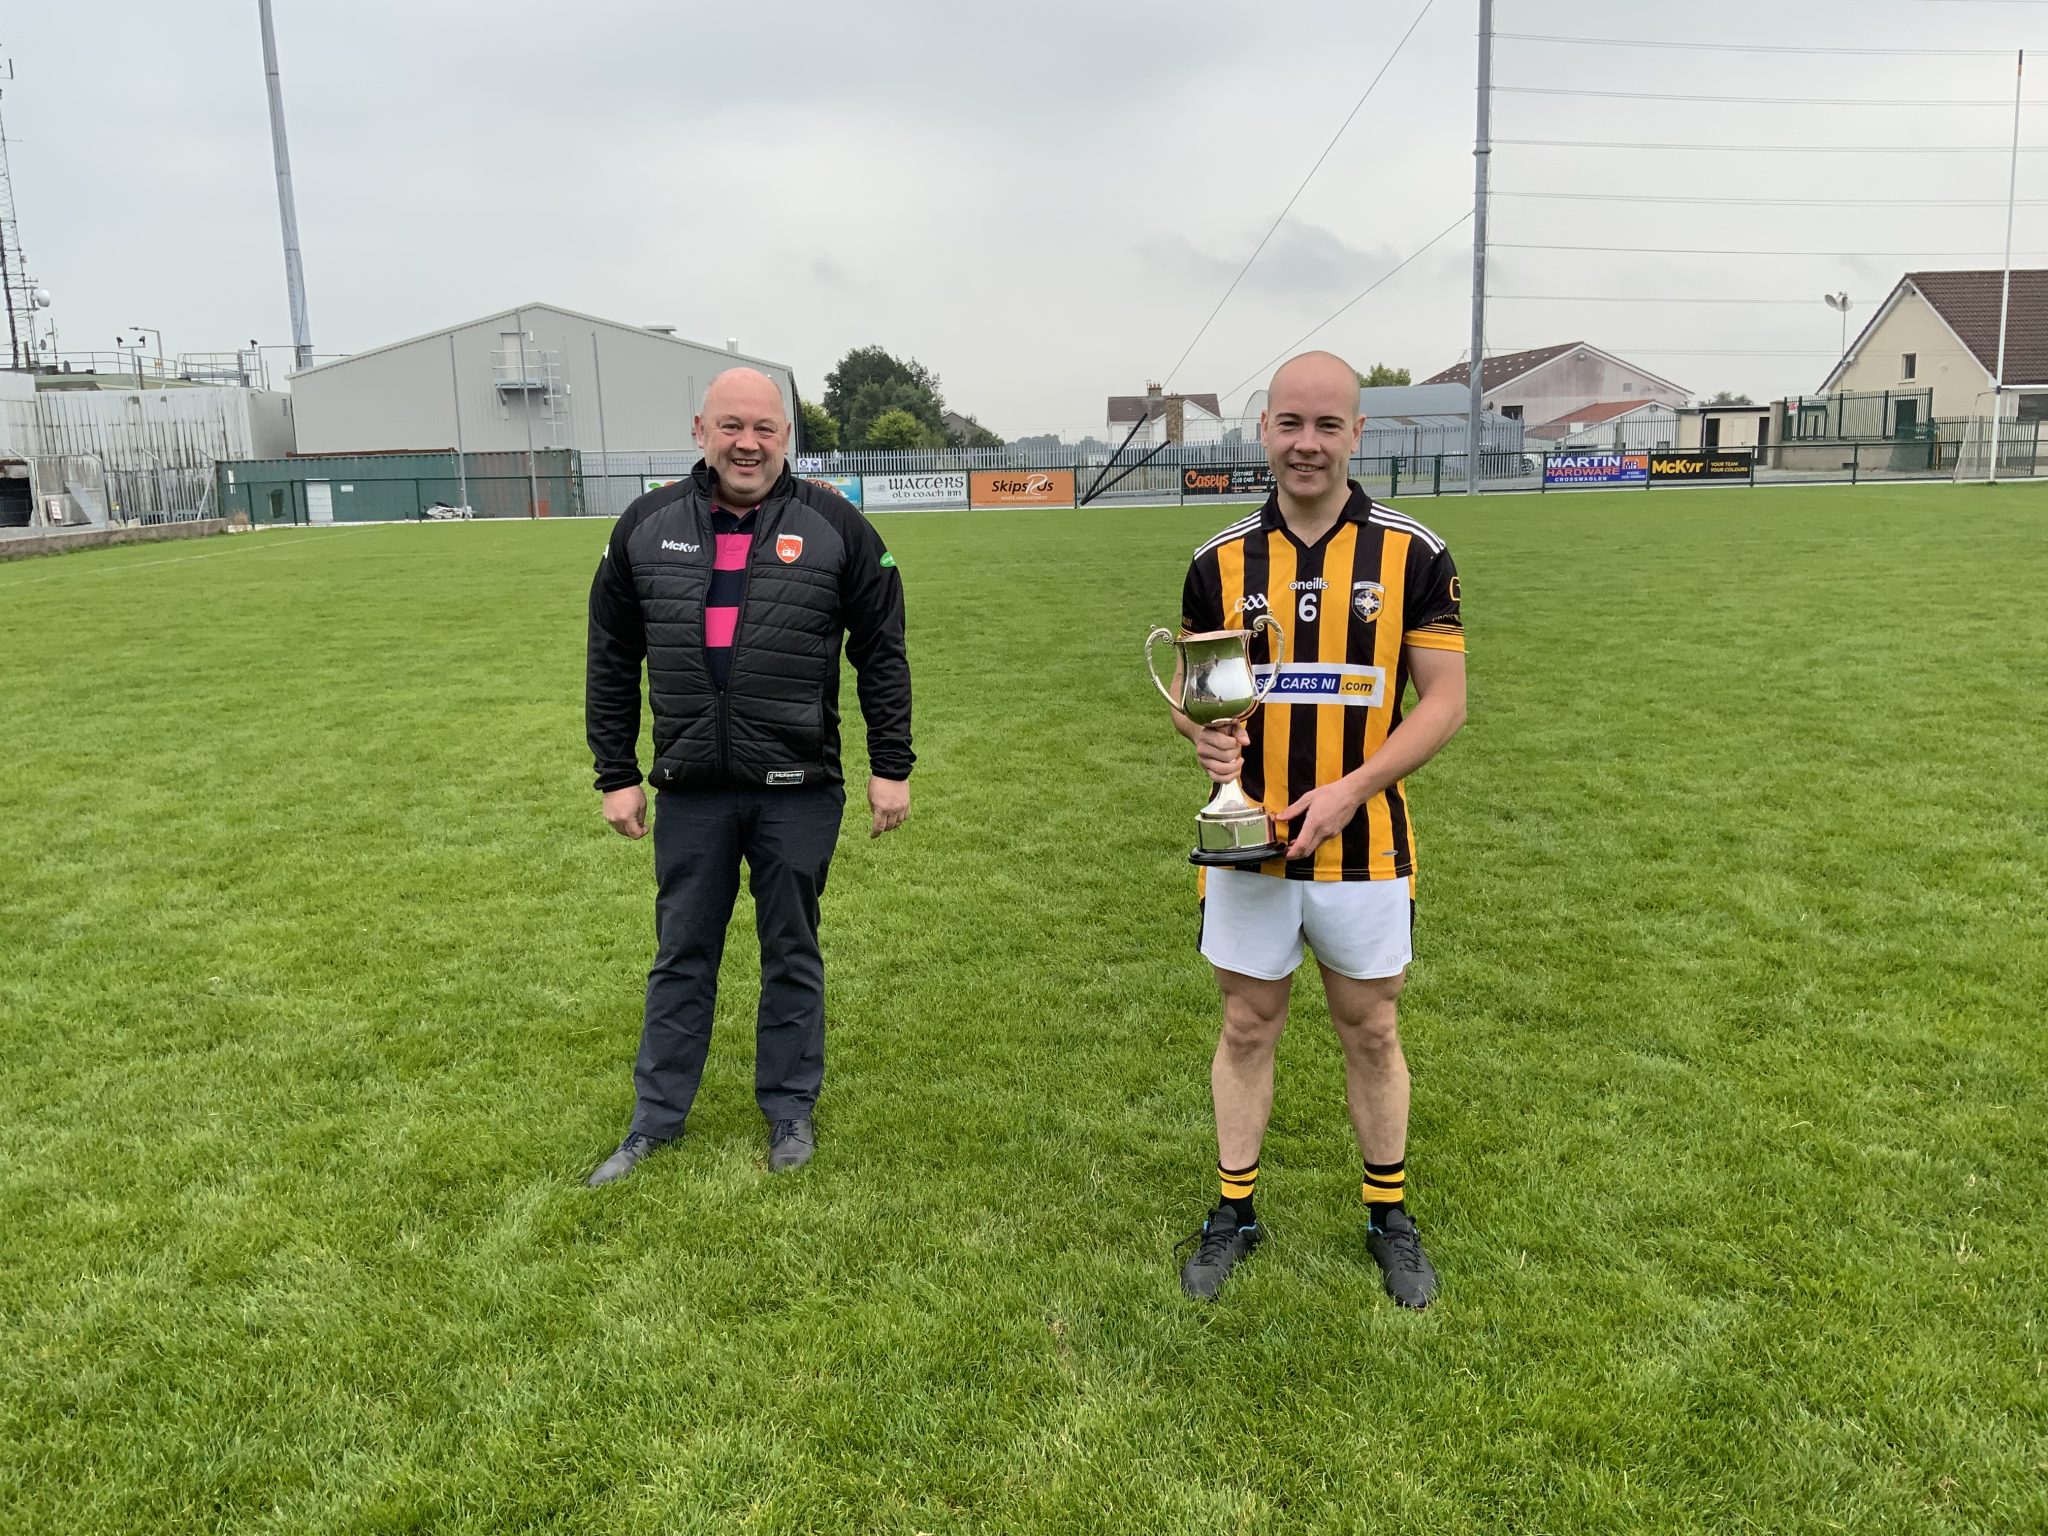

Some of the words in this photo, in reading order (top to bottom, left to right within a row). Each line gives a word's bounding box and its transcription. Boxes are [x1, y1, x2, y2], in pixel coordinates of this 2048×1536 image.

[1547, 456, 1620, 468] MARTIN
[1652, 459, 1704, 474] McKyr
[1546, 467, 1620, 477] HARDWARE
[889, 477, 964, 490] WATTERS
[1185, 470, 1230, 493] Caseys
[661, 539, 700, 553] McKyr
[1298, 592, 1317, 622] 6
[1280, 677, 1318, 690] CARS
[1321, 678, 1336, 690] NI
[1342, 682, 1373, 692] .com
